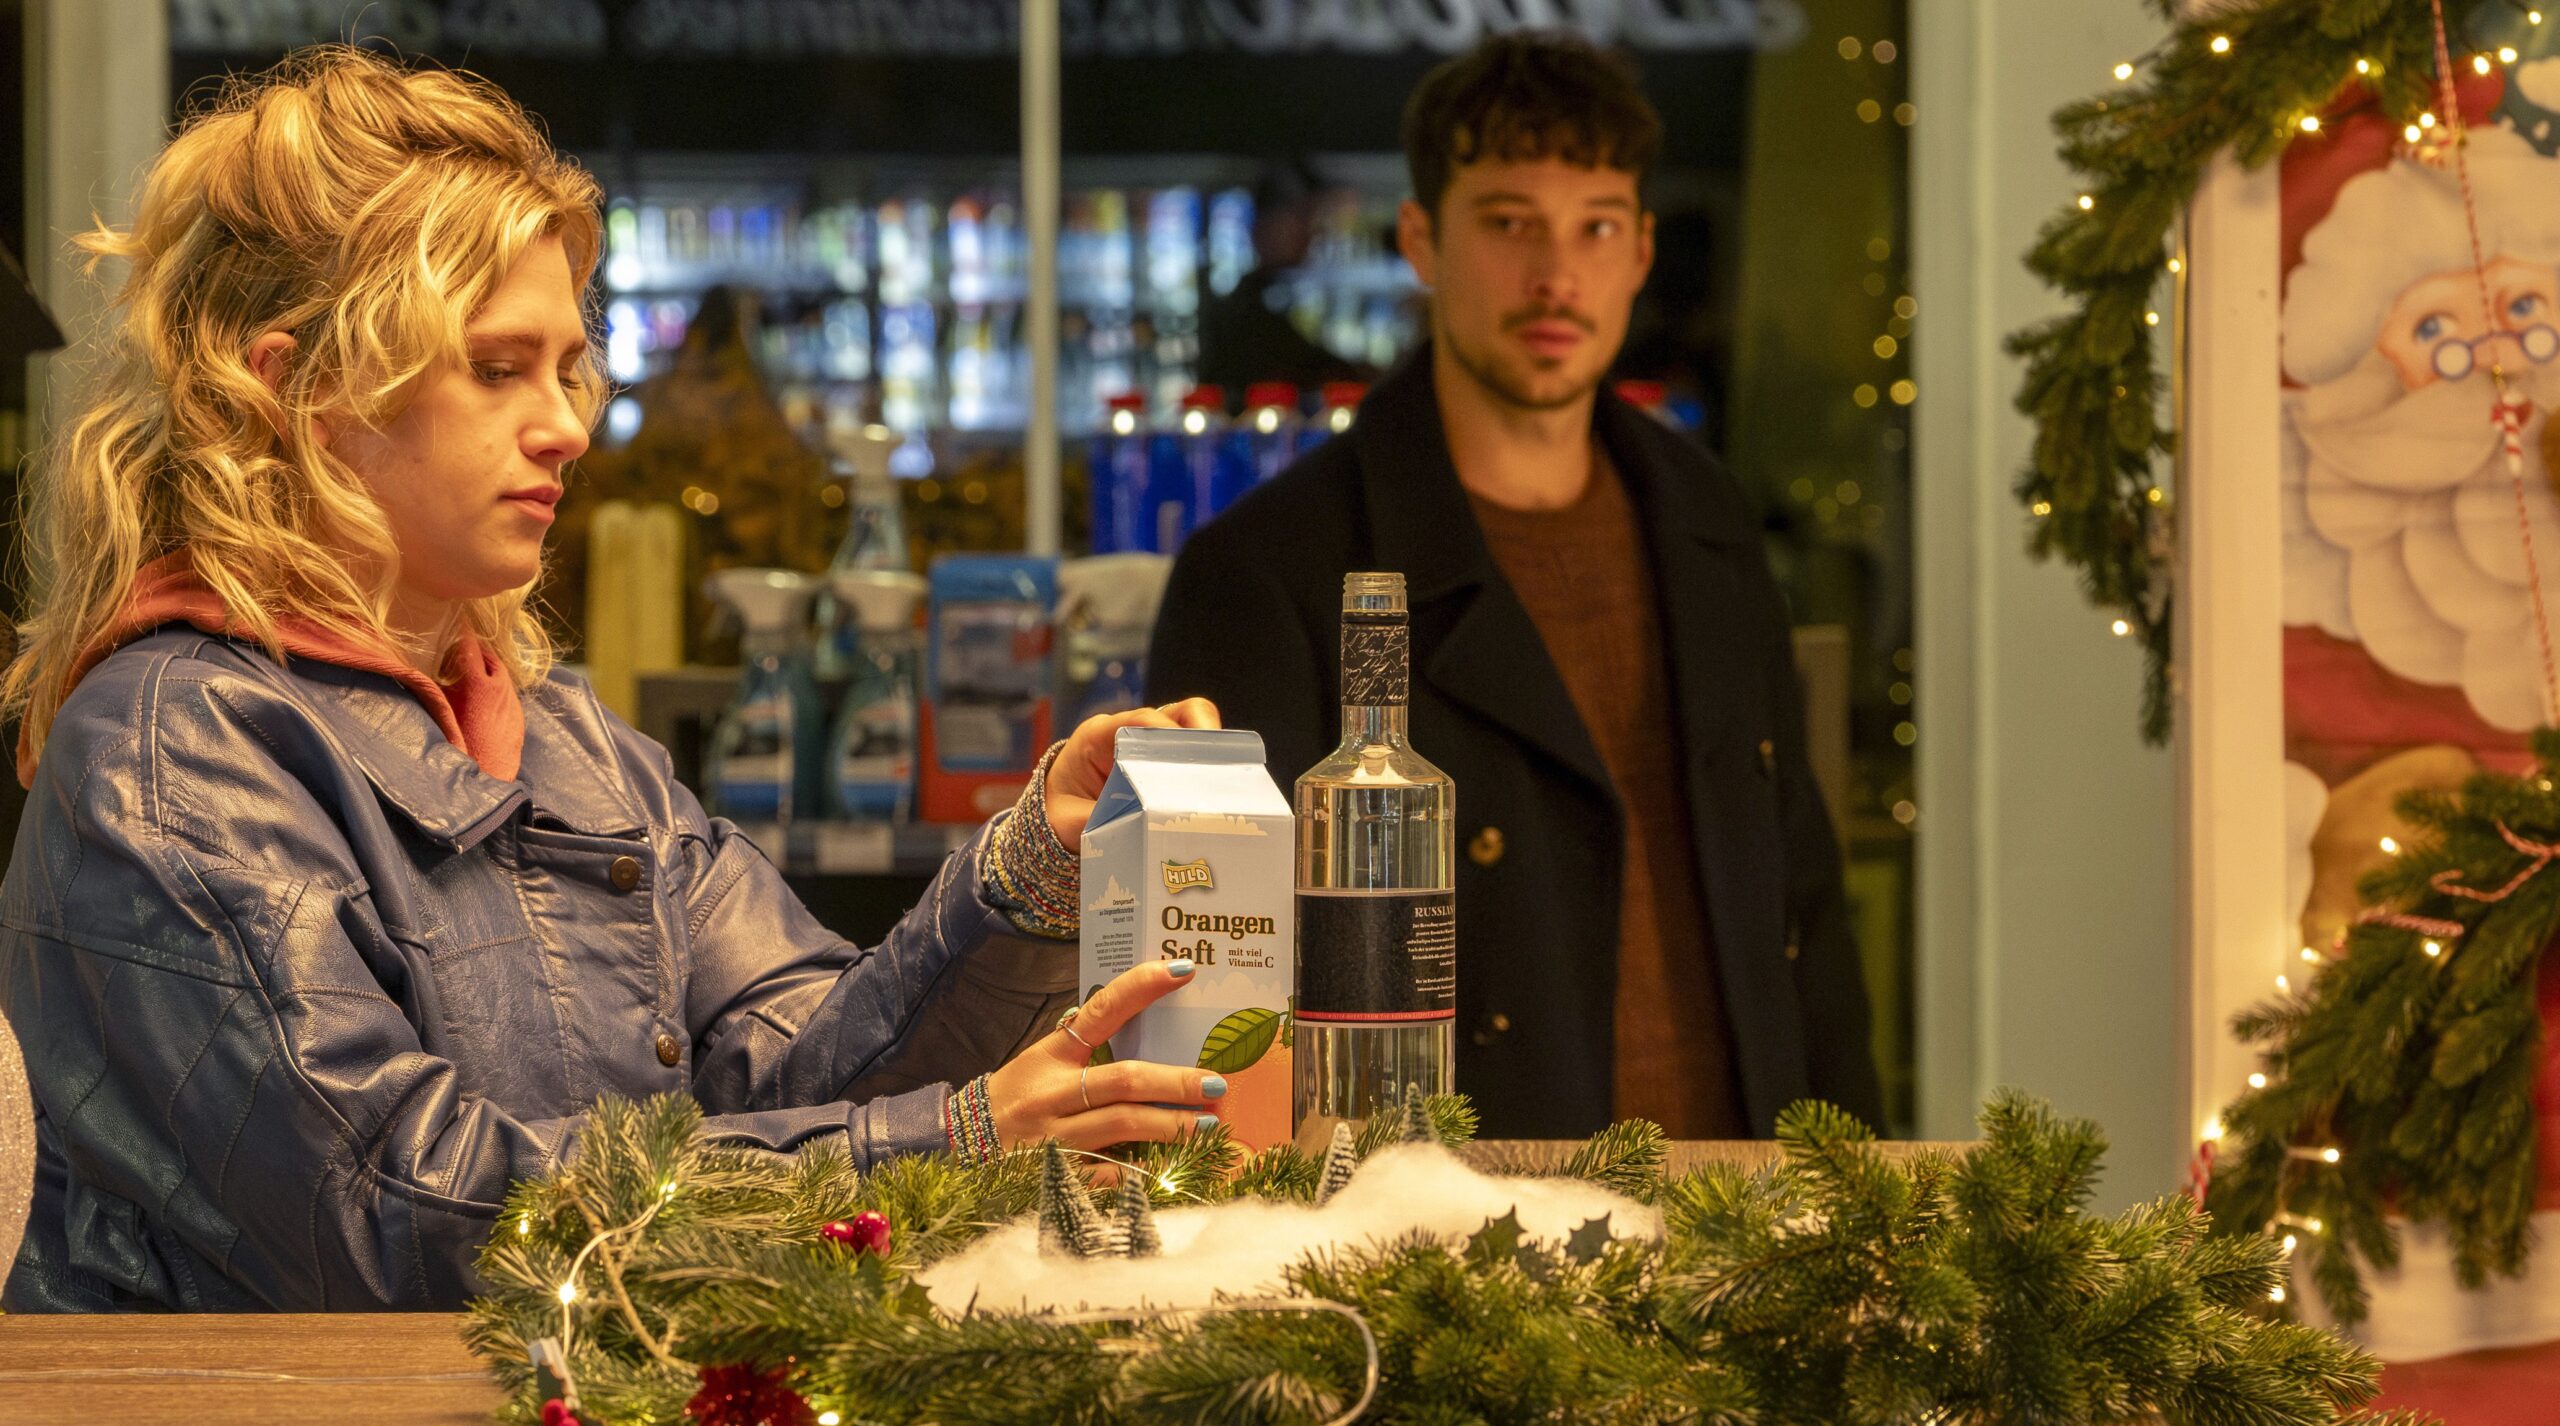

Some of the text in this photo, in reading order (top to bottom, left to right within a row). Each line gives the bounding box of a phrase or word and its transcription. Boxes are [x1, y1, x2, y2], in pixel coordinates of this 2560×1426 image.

[1166, 867, 1209, 885] HILD
[1161, 905, 1276, 940] Orangen
[1160, 939, 1216, 966] Saft
[1228, 947, 1262, 957] mit viel
[1228, 956, 1274, 969] Vitamin C
